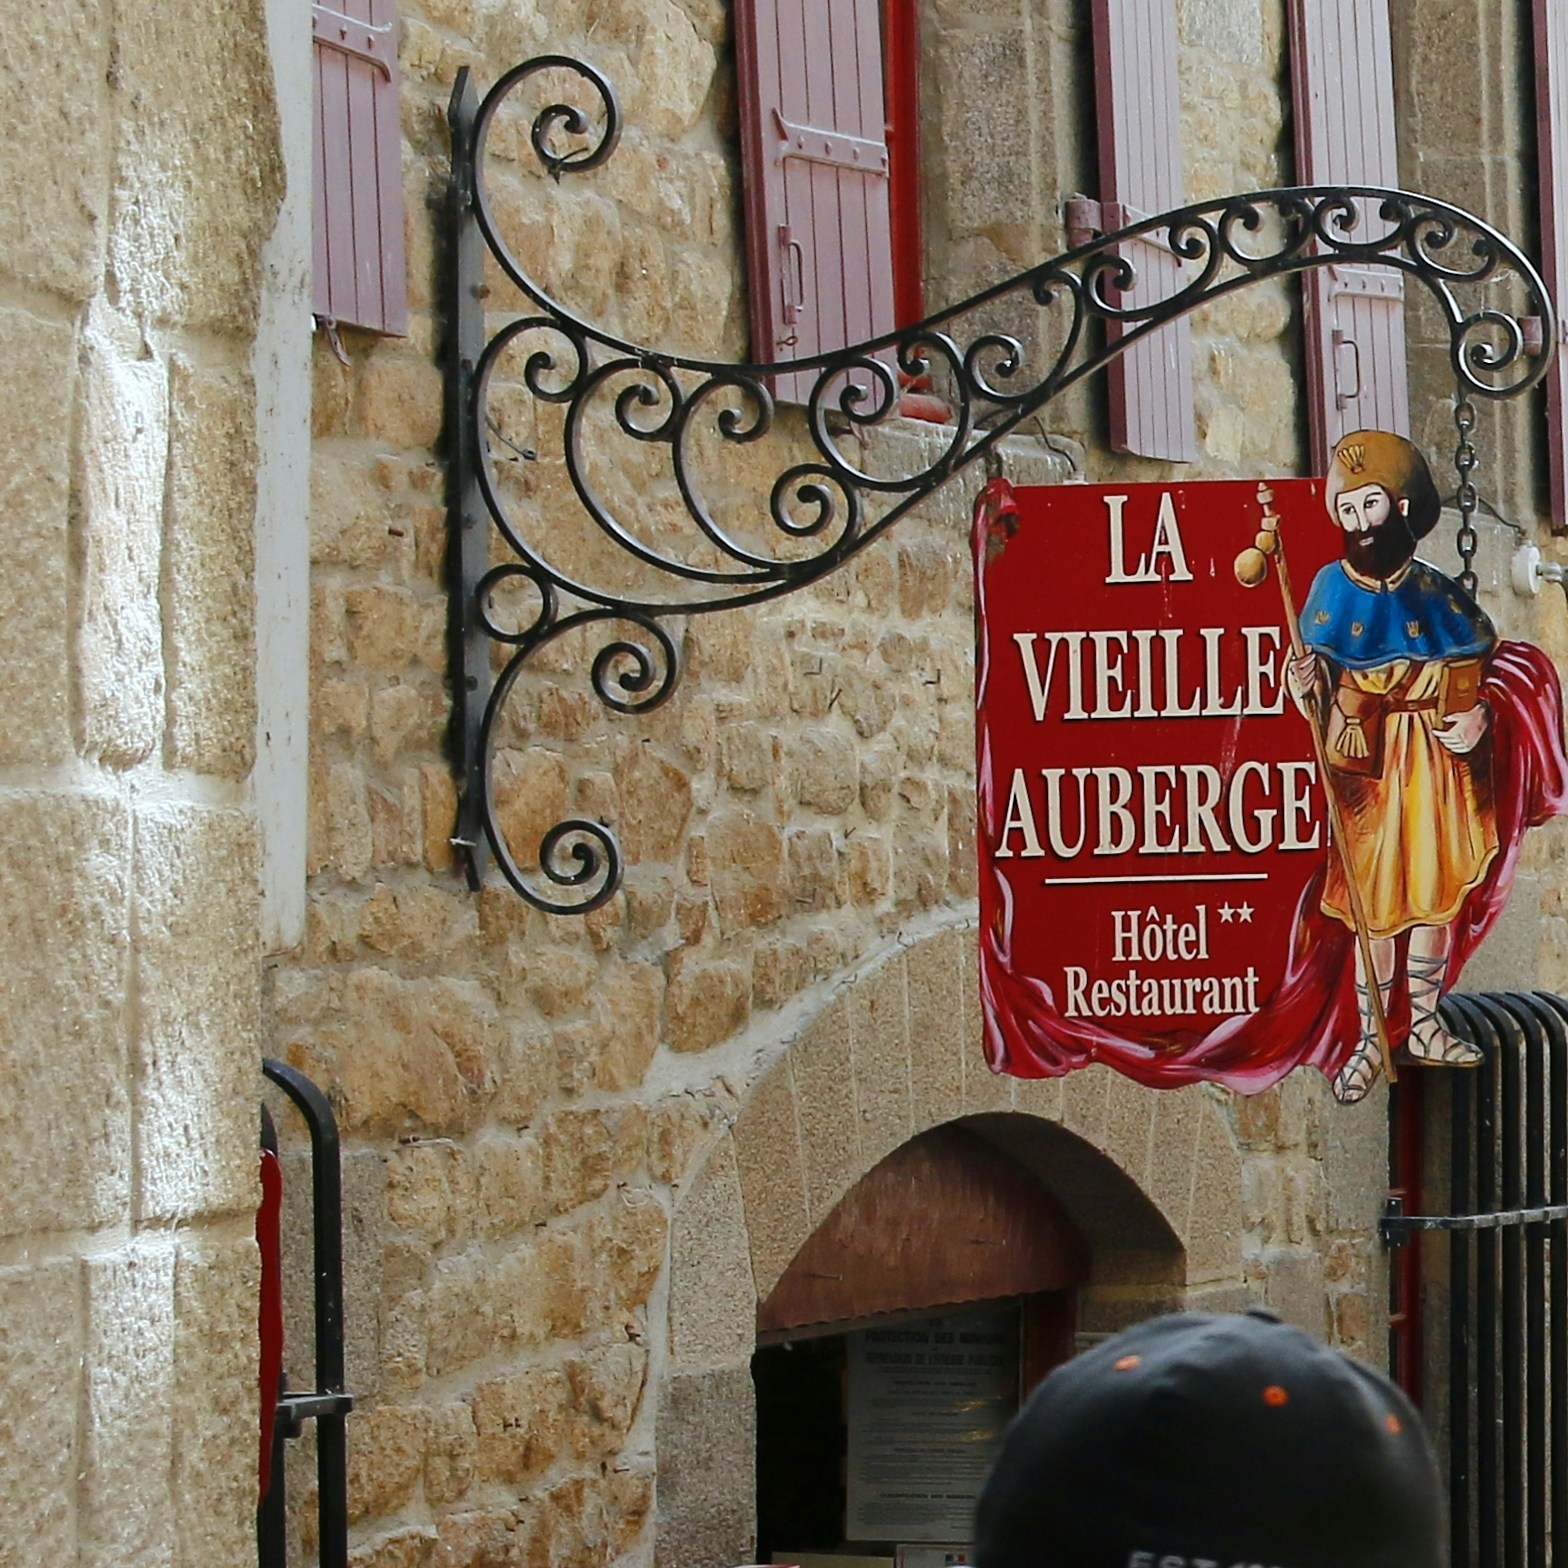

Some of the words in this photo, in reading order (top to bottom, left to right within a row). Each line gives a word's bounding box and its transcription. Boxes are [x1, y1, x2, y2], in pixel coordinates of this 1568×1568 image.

[1103, 492, 1194, 584] LA
[1013, 626, 1285, 722] VIEILLE
[995, 760, 1321, 858] AUBERGE
[1111, 903, 1210, 962] Hôtel
[1063, 966, 1260, 1017] Restaurant
